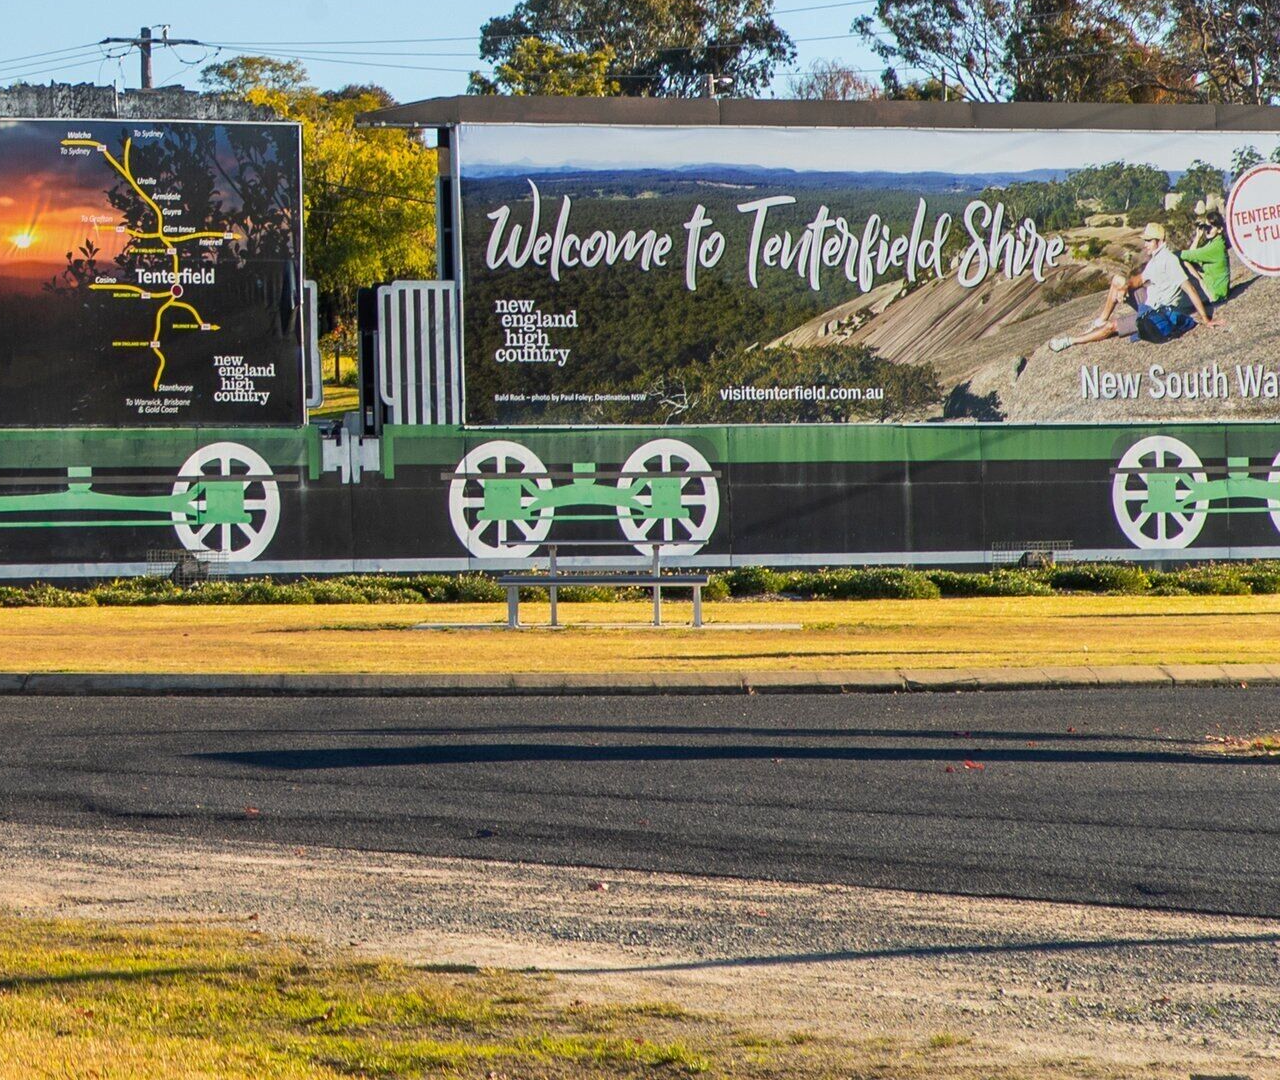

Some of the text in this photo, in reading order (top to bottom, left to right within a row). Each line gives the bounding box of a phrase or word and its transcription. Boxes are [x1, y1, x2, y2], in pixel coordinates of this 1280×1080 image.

[67, 131, 92, 140] Walcha
[134, 129, 164, 139] To Sydney
[60, 147, 68, 156] To
[69, 147, 91, 157] Sydney
[136, 177, 157, 186] Uralla
[151, 192, 182, 201] Armidale
[162, 207, 182, 217] Guyra
[163, 225, 196, 234] Glen Innes
[486, 178, 1065, 293] Welcome to Tenterfield Shire
[199, 238, 223, 246] Inverell
[95, 276, 117, 284] Casino
[135, 267, 215, 284] Tenterfield
[495, 299, 535, 314] new
[501, 310, 578, 332] england
[504, 329, 550, 351] high
[214, 355, 244, 367] new
[495, 346, 571, 367] country
[218, 363, 276, 380] england
[221, 377, 255, 394] high
[1081, 365, 1142, 400] New
[1149, 363, 1230, 400] South
[158, 383, 194, 393] Stanthorpe
[720, 385, 884, 401] visittenterfield.com.au
[126, 398, 191, 407] To Warwick, Brisbane
[214, 390, 270, 406] country
[494, 393, 509, 402] Bald
[510, 393, 525, 402] Rock
[531, 393, 551, 403] photo
[551, 393, 560, 404] by
[560, 393, 575, 402] Paul
[594, 393, 631, 402] Destination
[631, 393, 647, 402] NSW
[138, 405, 179, 414] & Gold Coast
